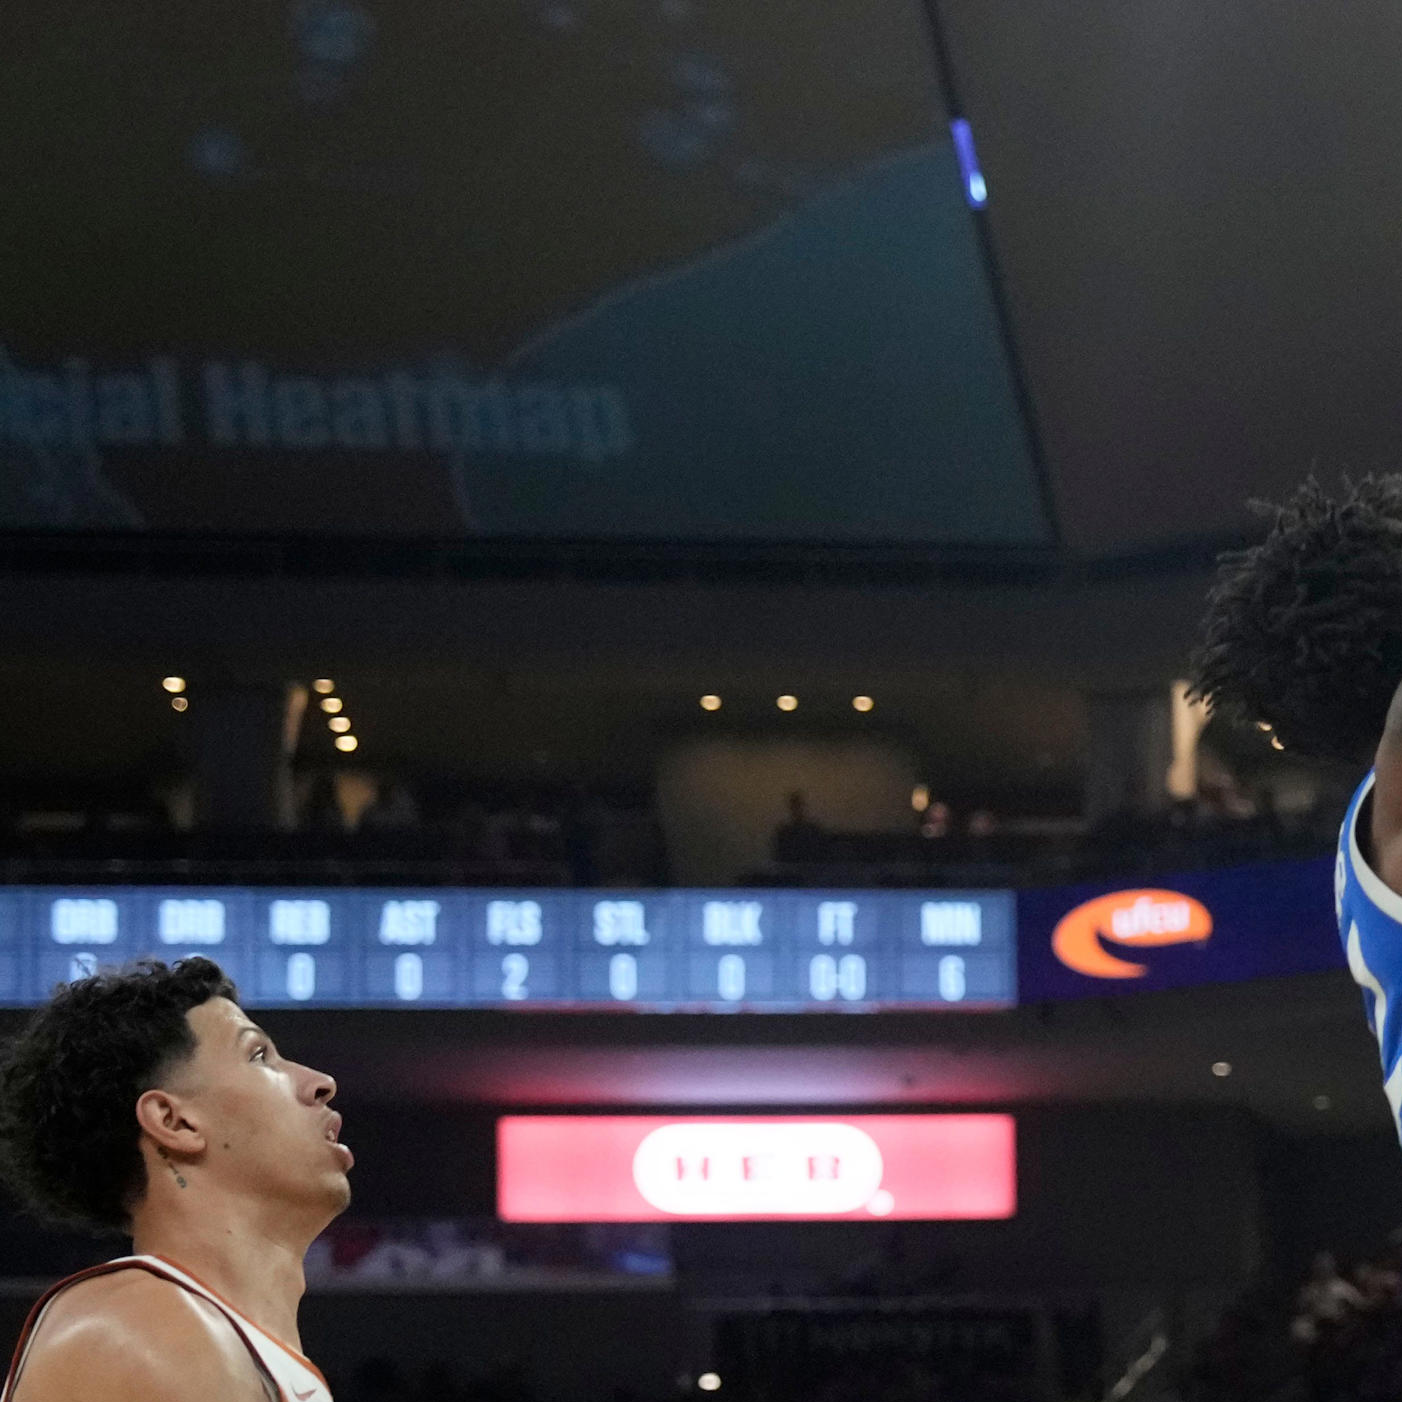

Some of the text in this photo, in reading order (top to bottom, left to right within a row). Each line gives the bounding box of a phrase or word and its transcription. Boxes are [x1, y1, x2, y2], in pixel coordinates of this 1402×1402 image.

[0, 355, 636, 462] cial Heatmap
[379, 901, 440, 945] AST
[502, 953, 529, 1000] 2
